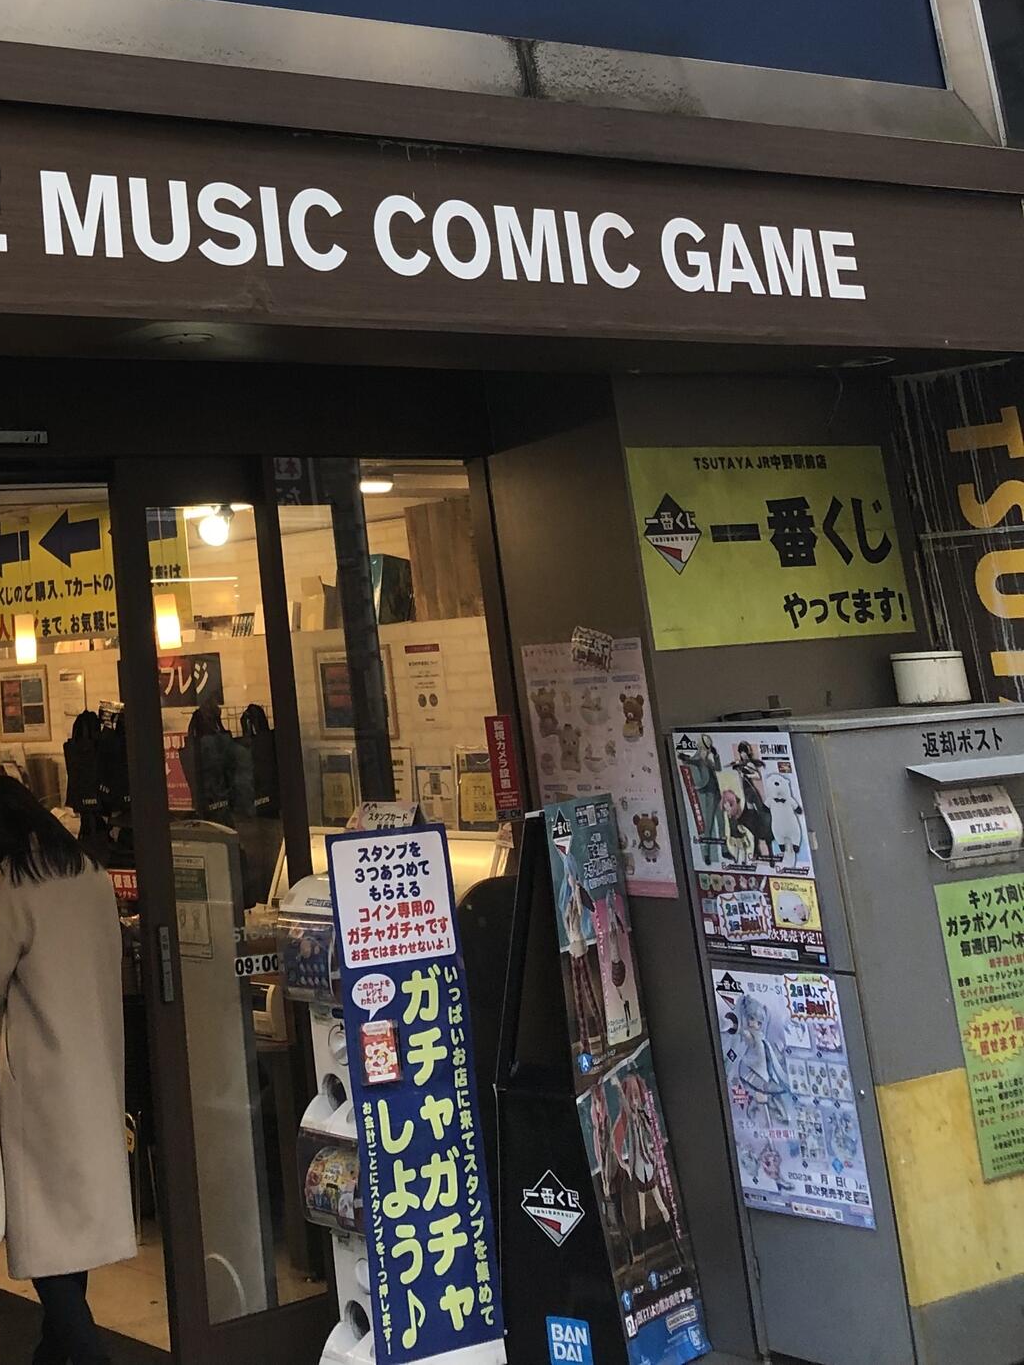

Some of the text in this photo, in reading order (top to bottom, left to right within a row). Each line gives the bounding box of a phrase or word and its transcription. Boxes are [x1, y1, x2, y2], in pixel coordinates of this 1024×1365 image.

[40, 169, 347, 274] MUSIC
[375, 195, 640, 289] COMIC
[661, 217, 866, 300] GAME
[694, 456, 753, 471] TSUTAYA
[645, 511, 696, 531] 一番くじ
[710, 495, 892, 568] 一番くじ
[783, 586, 908, 630] やってます!
[922, 727, 1003, 758] 返却ポスト
[493, 720, 512, 790] 監視カメラ設置
[357, 841, 421, 863] スタンプを
[355, 860, 430, 883] 3つあつめて
[369, 881, 421, 901] もらえる
[358, 900, 435, 923] コイン専用の
[347, 917, 449, 945] ガチャガチャです
[235, 955, 279, 976] 09:00
[525, 1187, 579, 1207] 一番くじ
[550, 1322, 588, 1347] BAN
[552, 1343, 584, 1364] DAI
